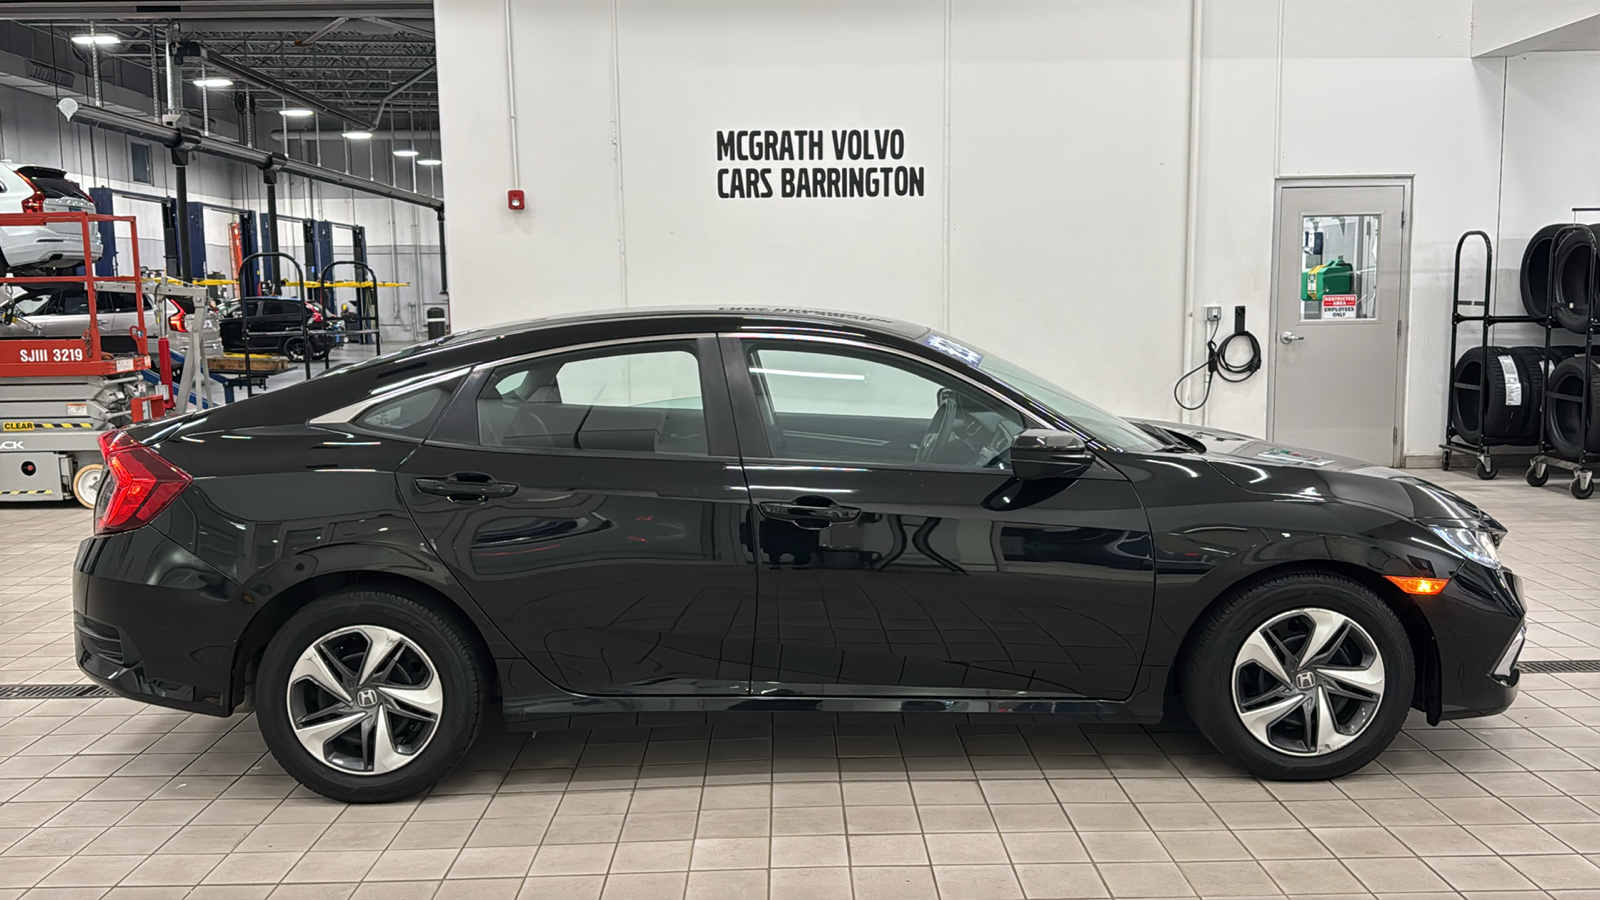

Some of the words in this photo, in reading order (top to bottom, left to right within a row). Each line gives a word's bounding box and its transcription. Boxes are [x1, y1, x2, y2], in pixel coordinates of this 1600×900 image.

[716, 130, 823, 161] MCGRATH
[831, 129, 904, 160] VOLVO
[717, 168, 773, 198] CARS
[781, 166, 925, 198] BARRINGTON
[20, 349, 48, 362] SJIII
[53, 349, 83, 361] 3219
[4, 422, 33, 430] CLEAR
